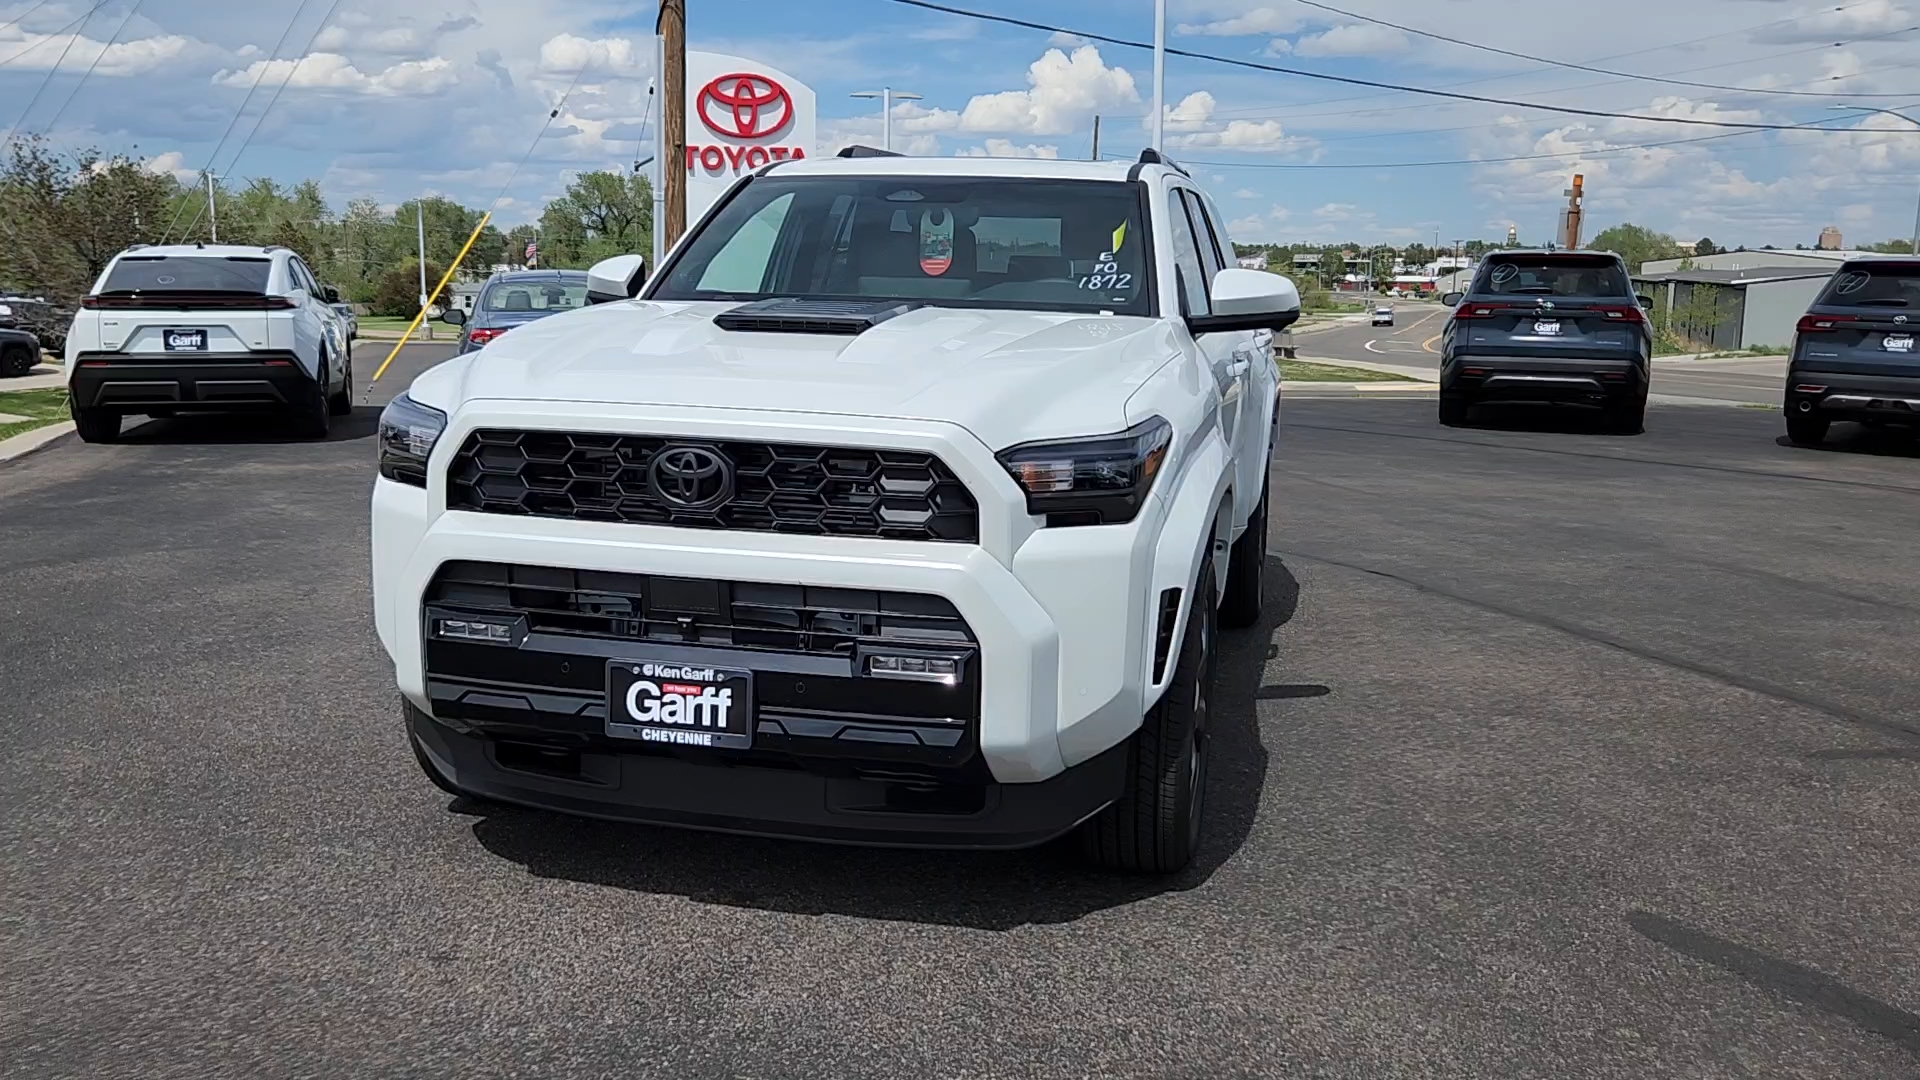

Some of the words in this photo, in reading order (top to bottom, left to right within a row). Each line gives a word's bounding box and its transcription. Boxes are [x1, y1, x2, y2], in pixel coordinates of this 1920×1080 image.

[1079, 273, 1132, 290] 1872
[654, 664, 680, 679] Ken
[681, 667, 714, 682] Garff
[626, 680, 732, 728] Garff
[641, 728, 712, 746] CHEYENNE
